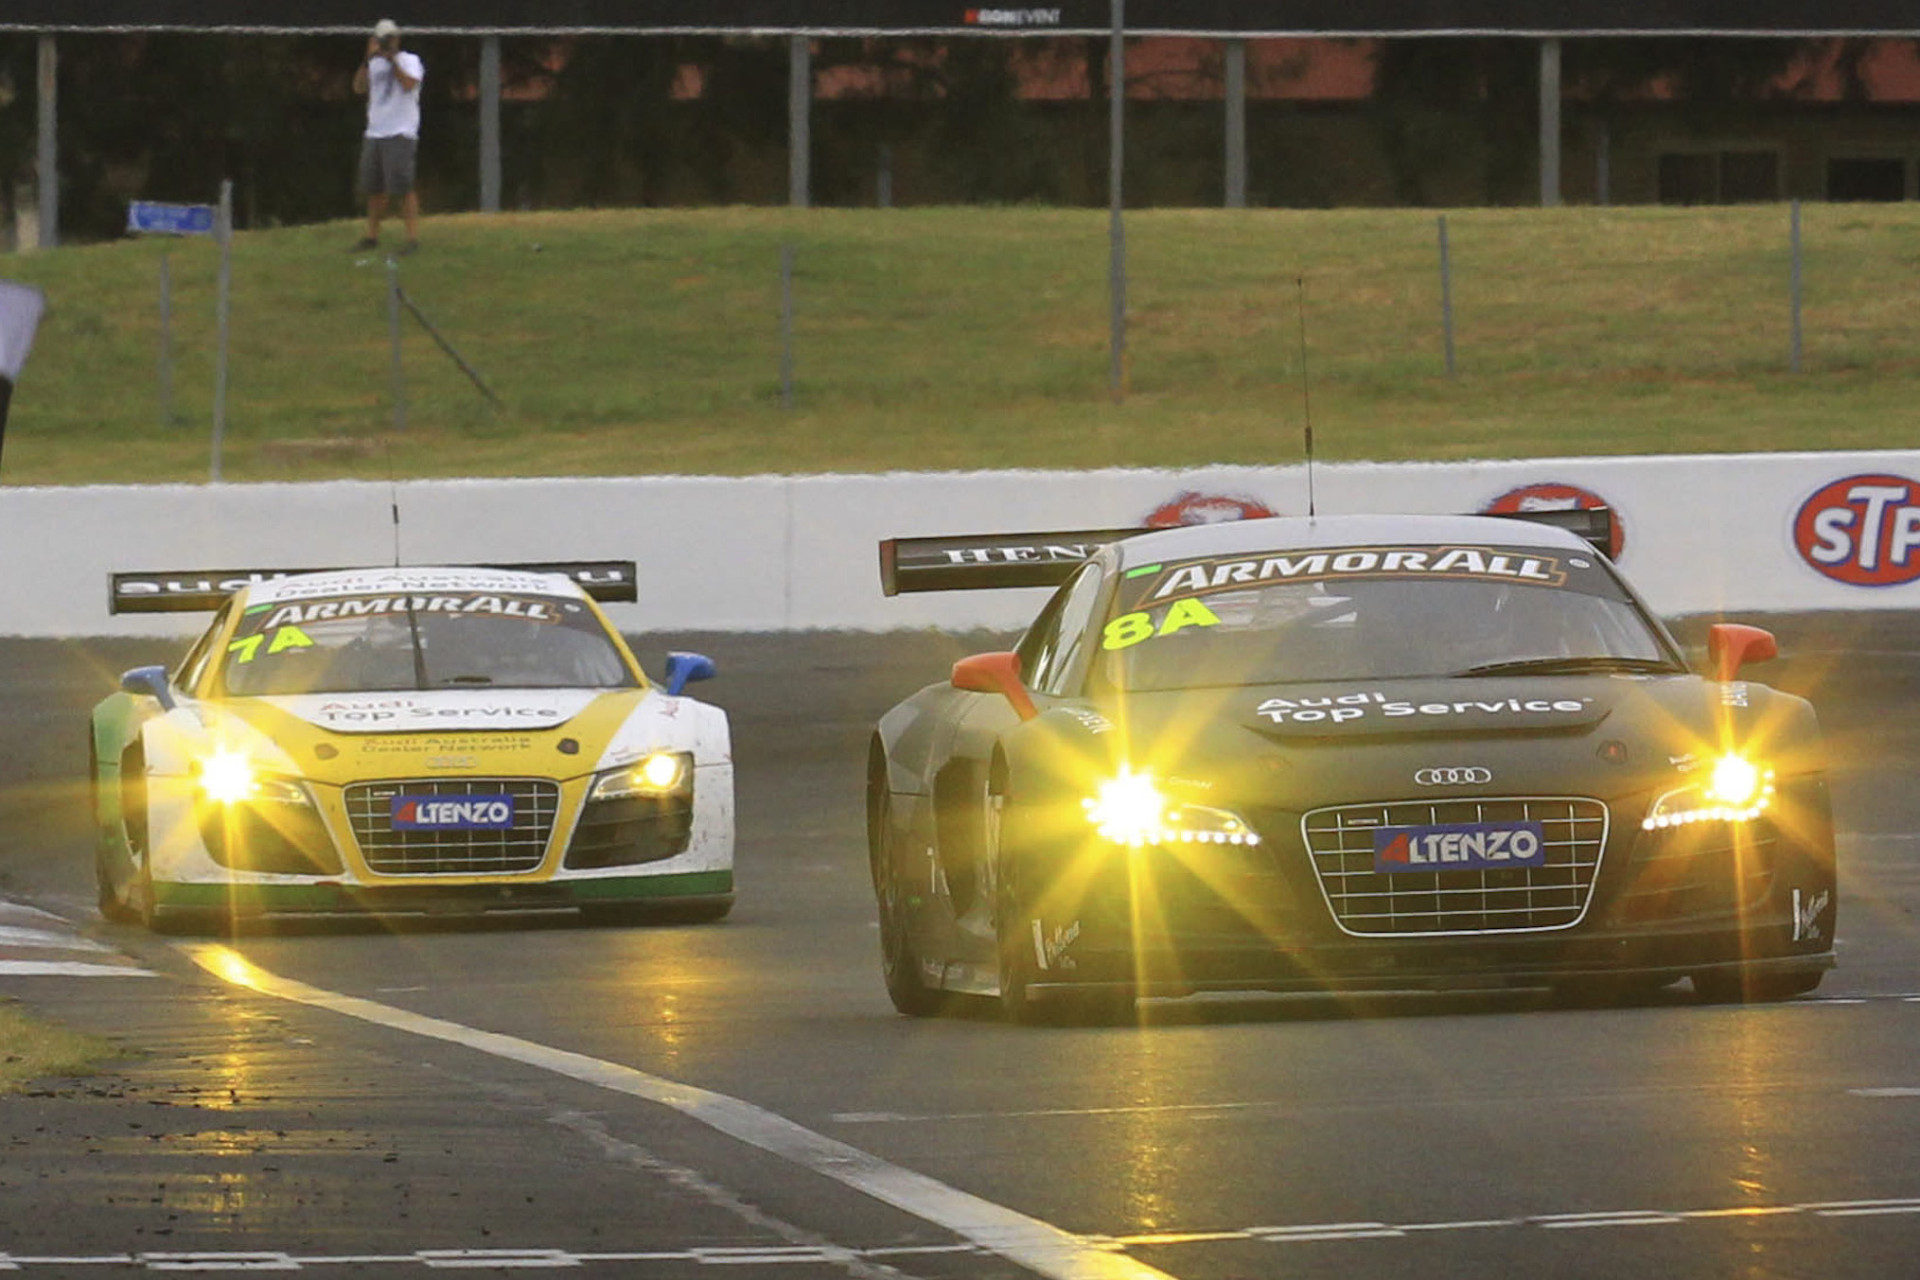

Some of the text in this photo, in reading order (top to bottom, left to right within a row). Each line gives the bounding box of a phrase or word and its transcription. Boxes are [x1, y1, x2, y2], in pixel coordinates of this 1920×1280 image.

[1810, 486, 1920, 571] STP
[942, 543, 1107, 562] HEN
[118, 572, 286, 595] aud
[401, 581, 550, 591] Network
[1102, 597, 1222, 650] 8A
[228, 625, 315, 664] 7A
[319, 700, 415, 712] Audi
[1257, 692, 1387, 711] Audi
[1257, 698, 1583, 723] Top Service
[322, 707, 559, 722] Top Service
[424, 737, 531, 745] Australia
[439, 743, 532, 752] Network
[394, 801, 510, 825] ALTENZO
[1380, 829, 1540, 865] ALTENZO
